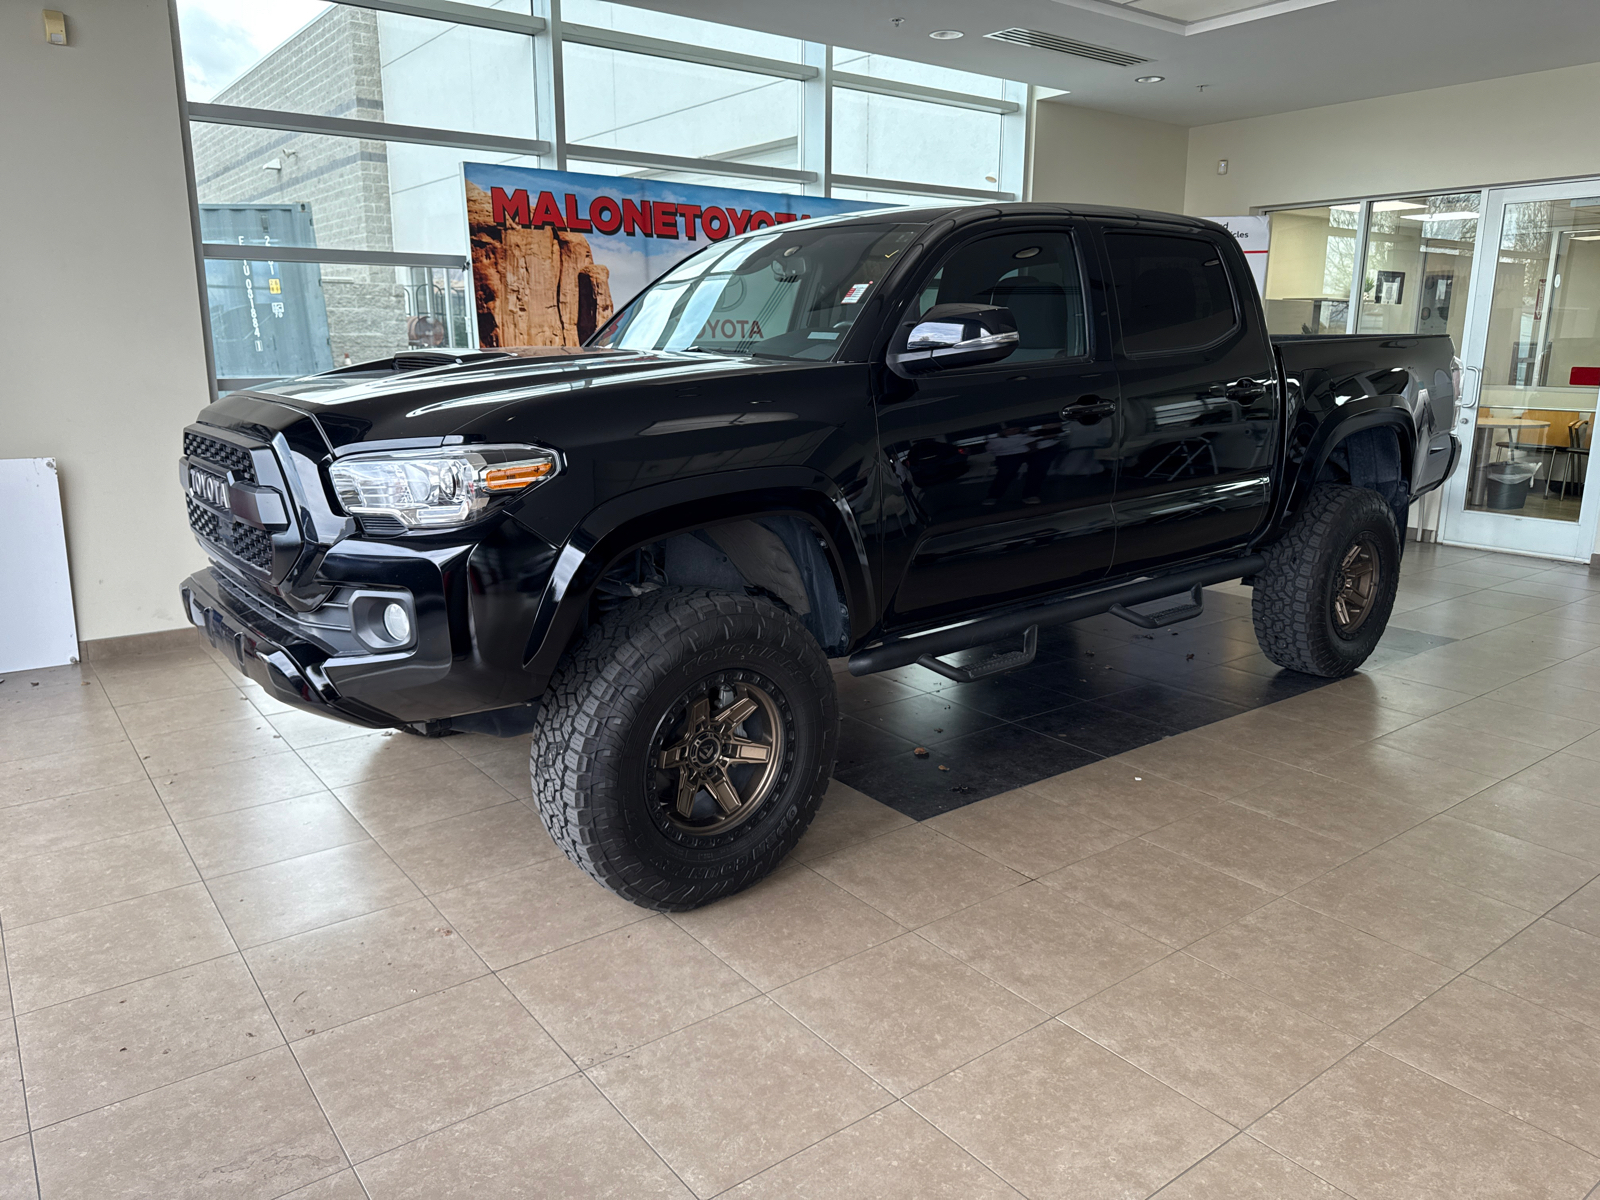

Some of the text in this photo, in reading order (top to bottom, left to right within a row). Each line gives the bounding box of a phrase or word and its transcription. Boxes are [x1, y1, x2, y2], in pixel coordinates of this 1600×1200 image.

[696, 318, 765, 339] YOTA
[190, 469, 231, 508] TOYOTA
[682, 641, 808, 684] TOYO TIRES
